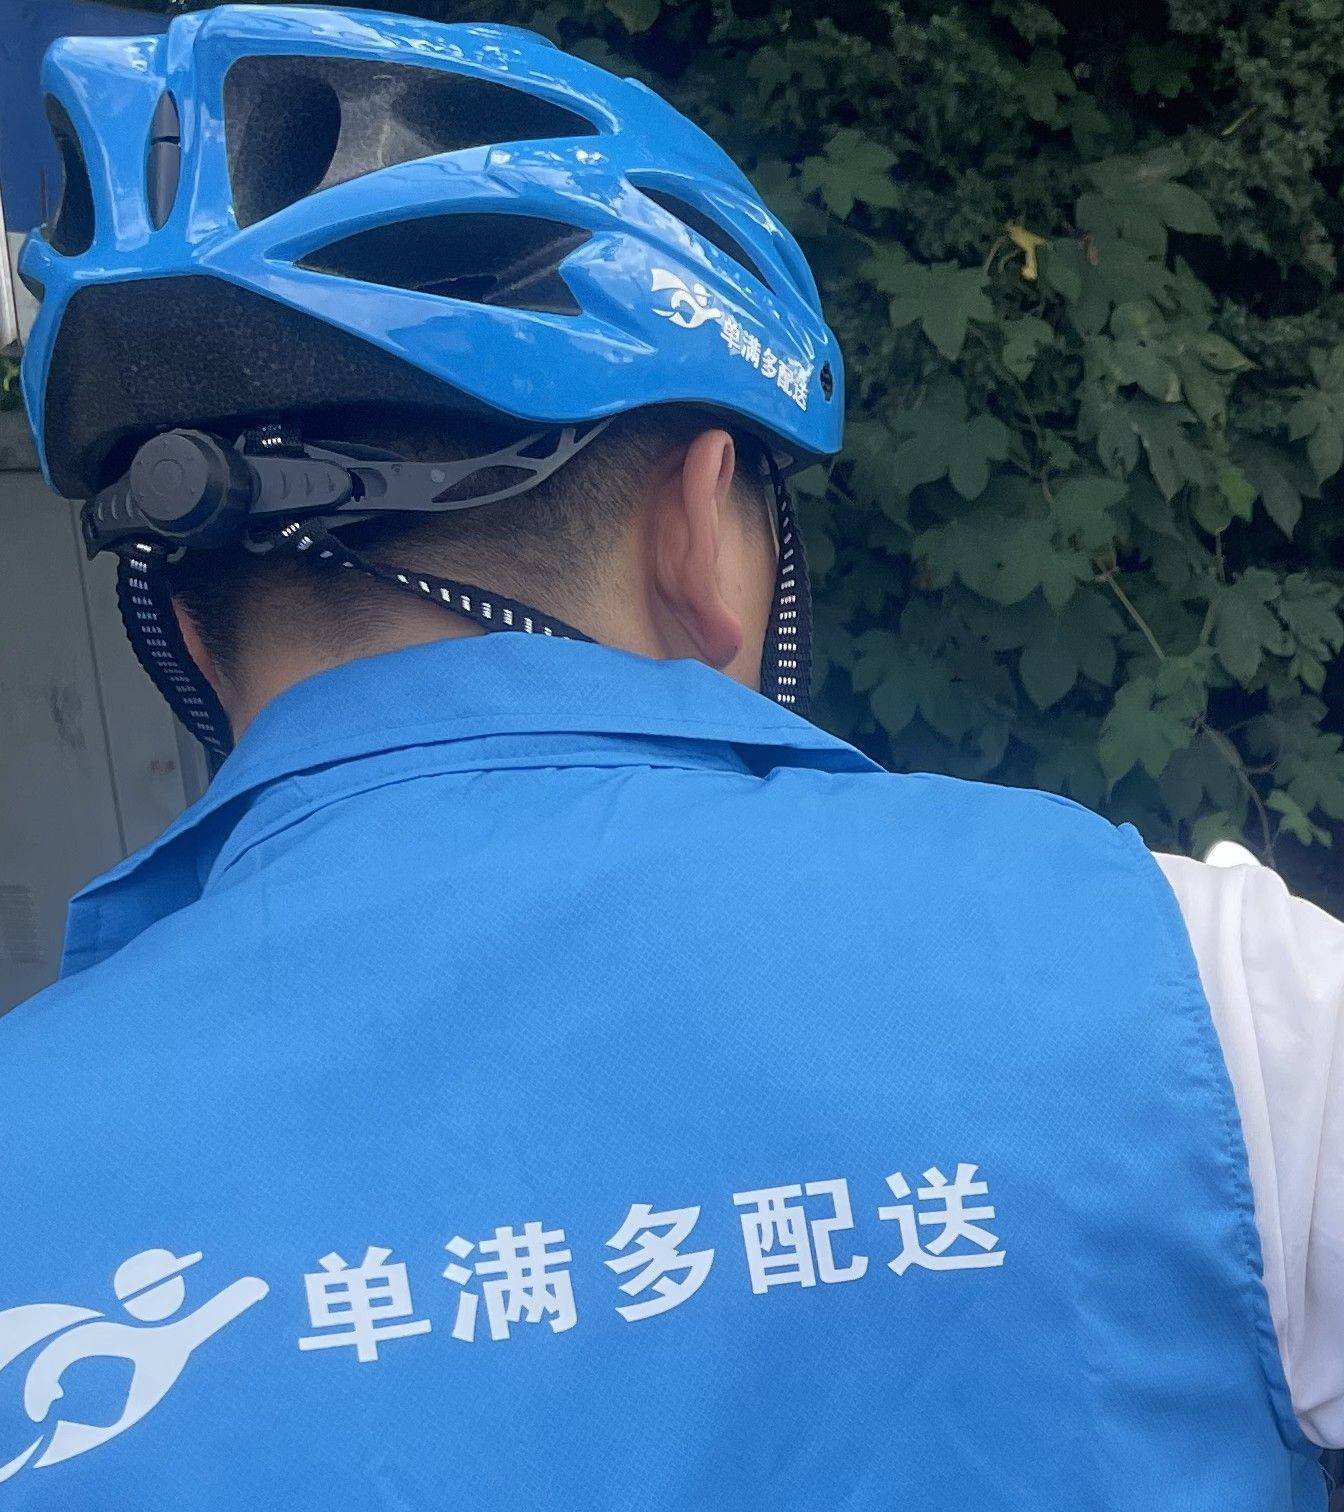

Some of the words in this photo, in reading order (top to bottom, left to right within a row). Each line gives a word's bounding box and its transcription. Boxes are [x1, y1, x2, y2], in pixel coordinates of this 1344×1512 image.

[298, 1161, 1007, 1364] 单满多配送
